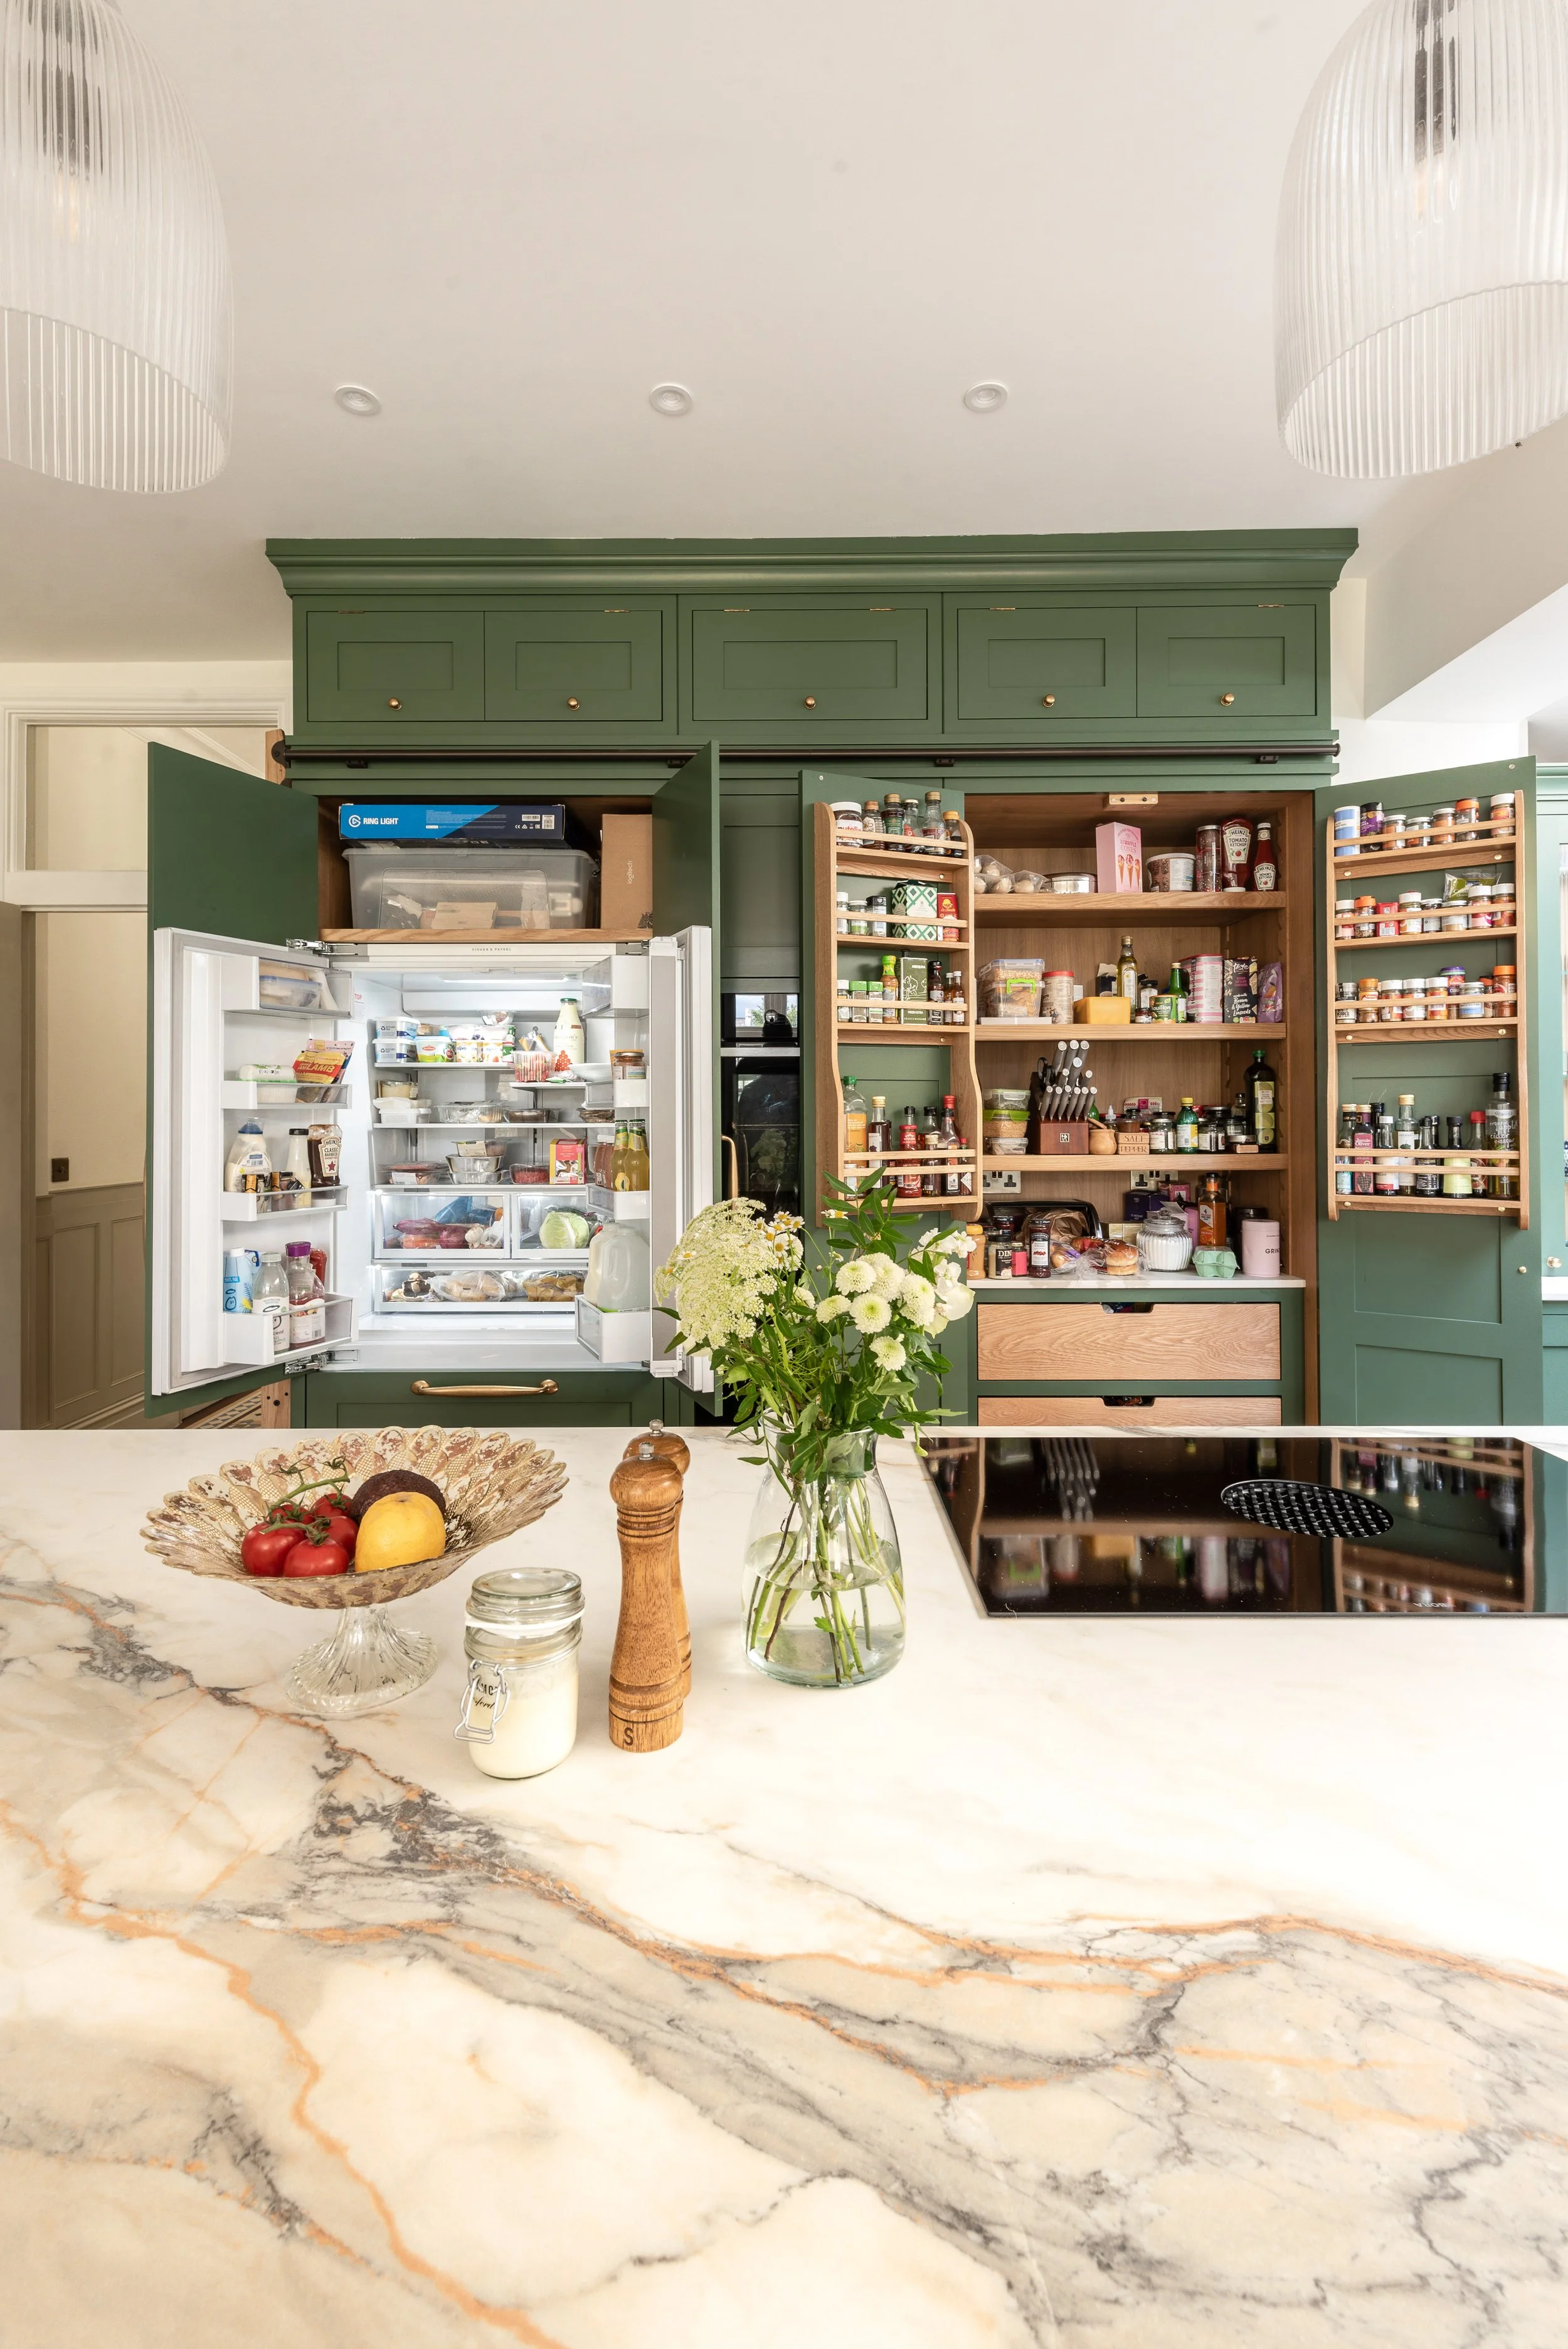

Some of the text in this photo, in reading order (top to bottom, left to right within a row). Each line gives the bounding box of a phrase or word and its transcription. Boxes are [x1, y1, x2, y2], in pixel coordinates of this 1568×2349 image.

[1121, 845, 1136, 853] CONES
[1236, 1003, 1251, 1011] Yellow
[1233, 1008, 1251, 1016] Linseeds
[306, 1063, 335, 1073] LAMB
[1494, 1138, 1515, 1148] vinegar
[624, 1727, 633, 1746] S
